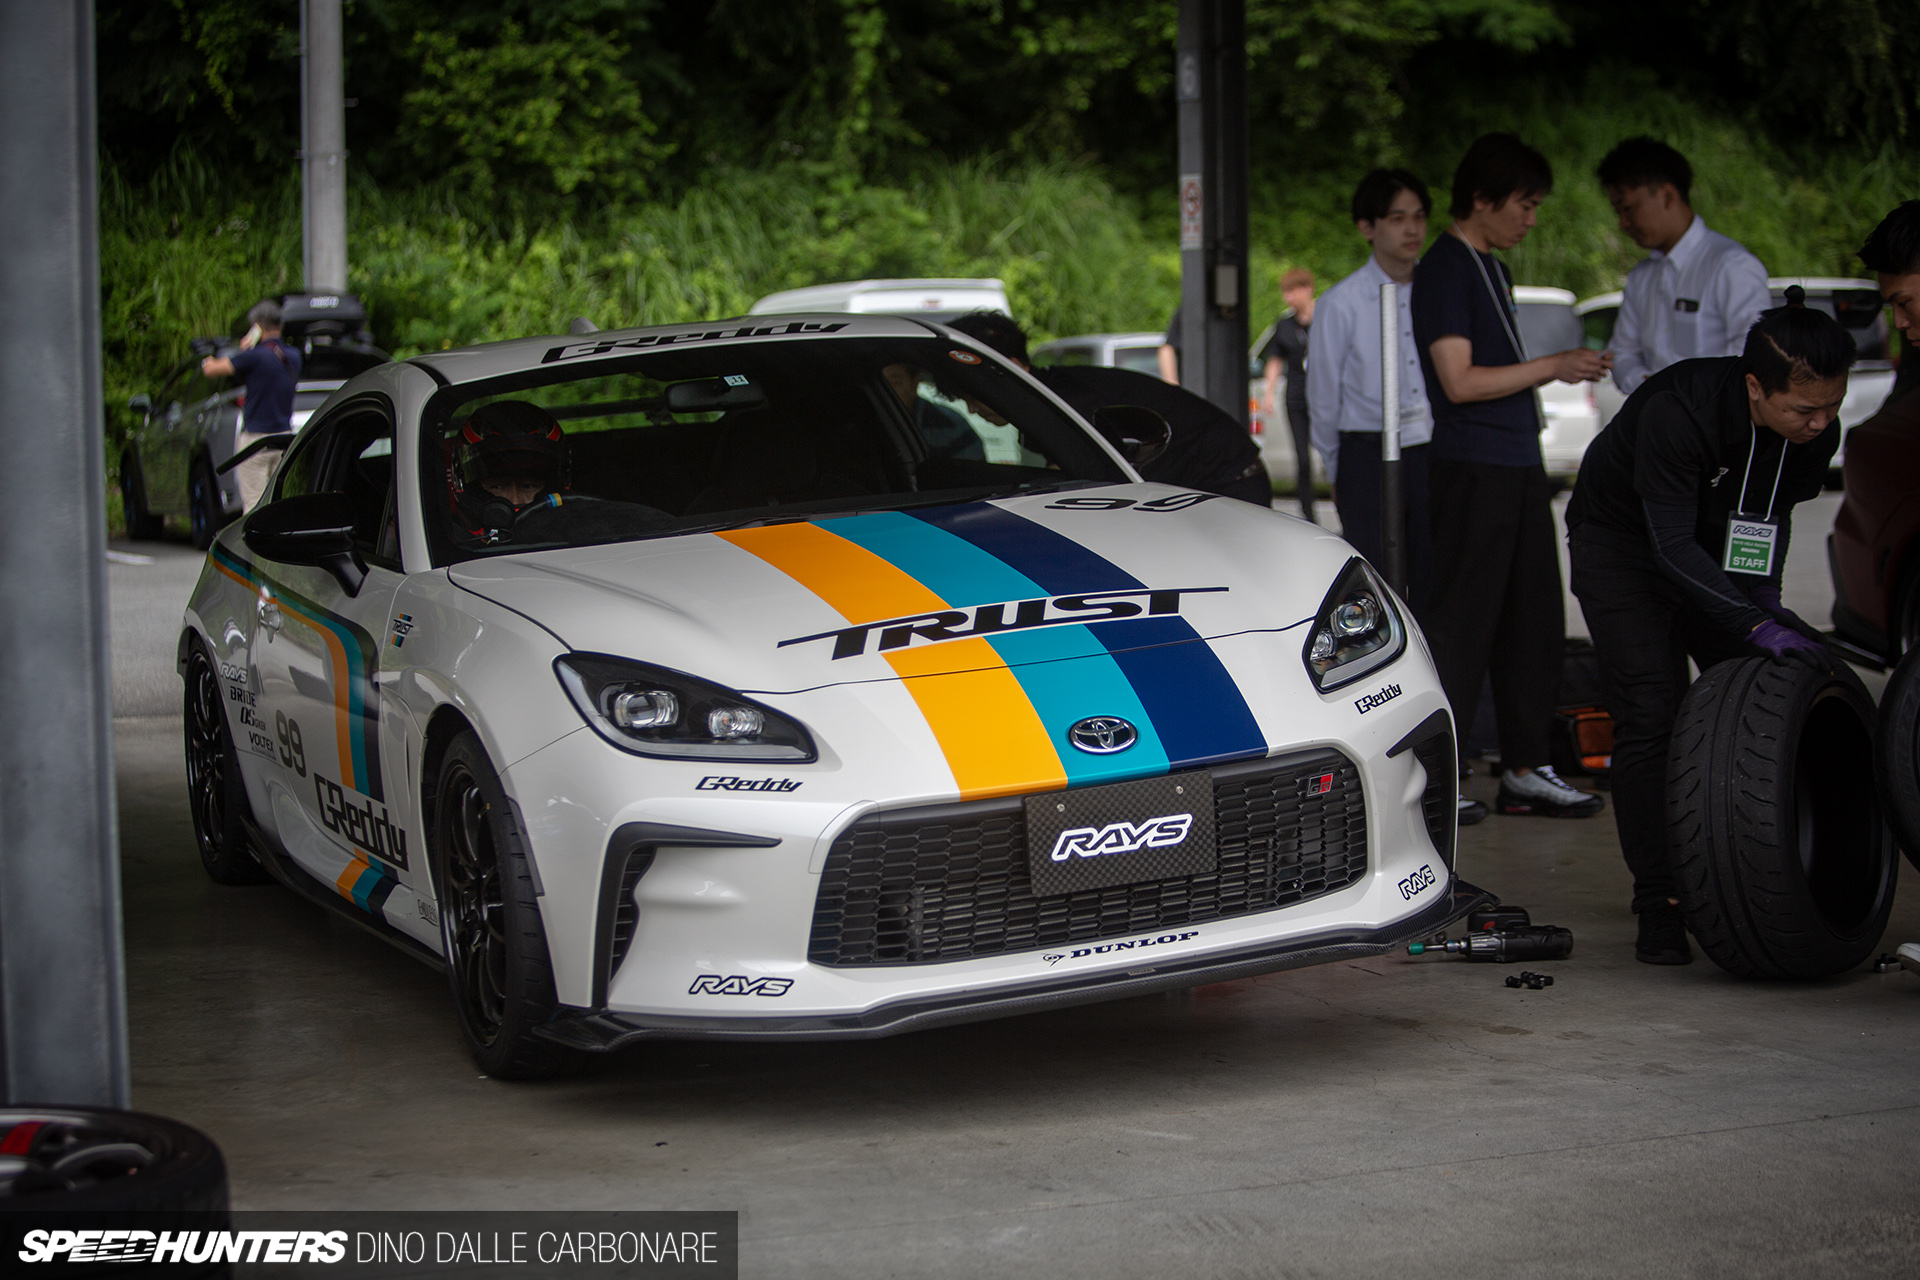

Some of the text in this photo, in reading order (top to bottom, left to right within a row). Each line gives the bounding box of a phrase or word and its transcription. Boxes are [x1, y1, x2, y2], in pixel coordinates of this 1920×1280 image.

[1044, 493, 1223, 512] 99
[1733, 524, 1772, 538] RAYS
[1732, 556, 1766, 569] STAFF
[776, 586, 1230, 661] TRUST
[220, 661, 248, 684] RAYS
[230, 685, 256, 707] BRIDE
[240, 706, 256, 727] OS
[248, 731, 275, 752] VOLTEX
[275, 709, 307, 778] 99
[1051, 813, 1193, 862] RAYS
[1397, 864, 1436, 900] RAYS
[1070, 931, 1199, 959] DUNLOP
[688, 974, 795, 997] RAYS
